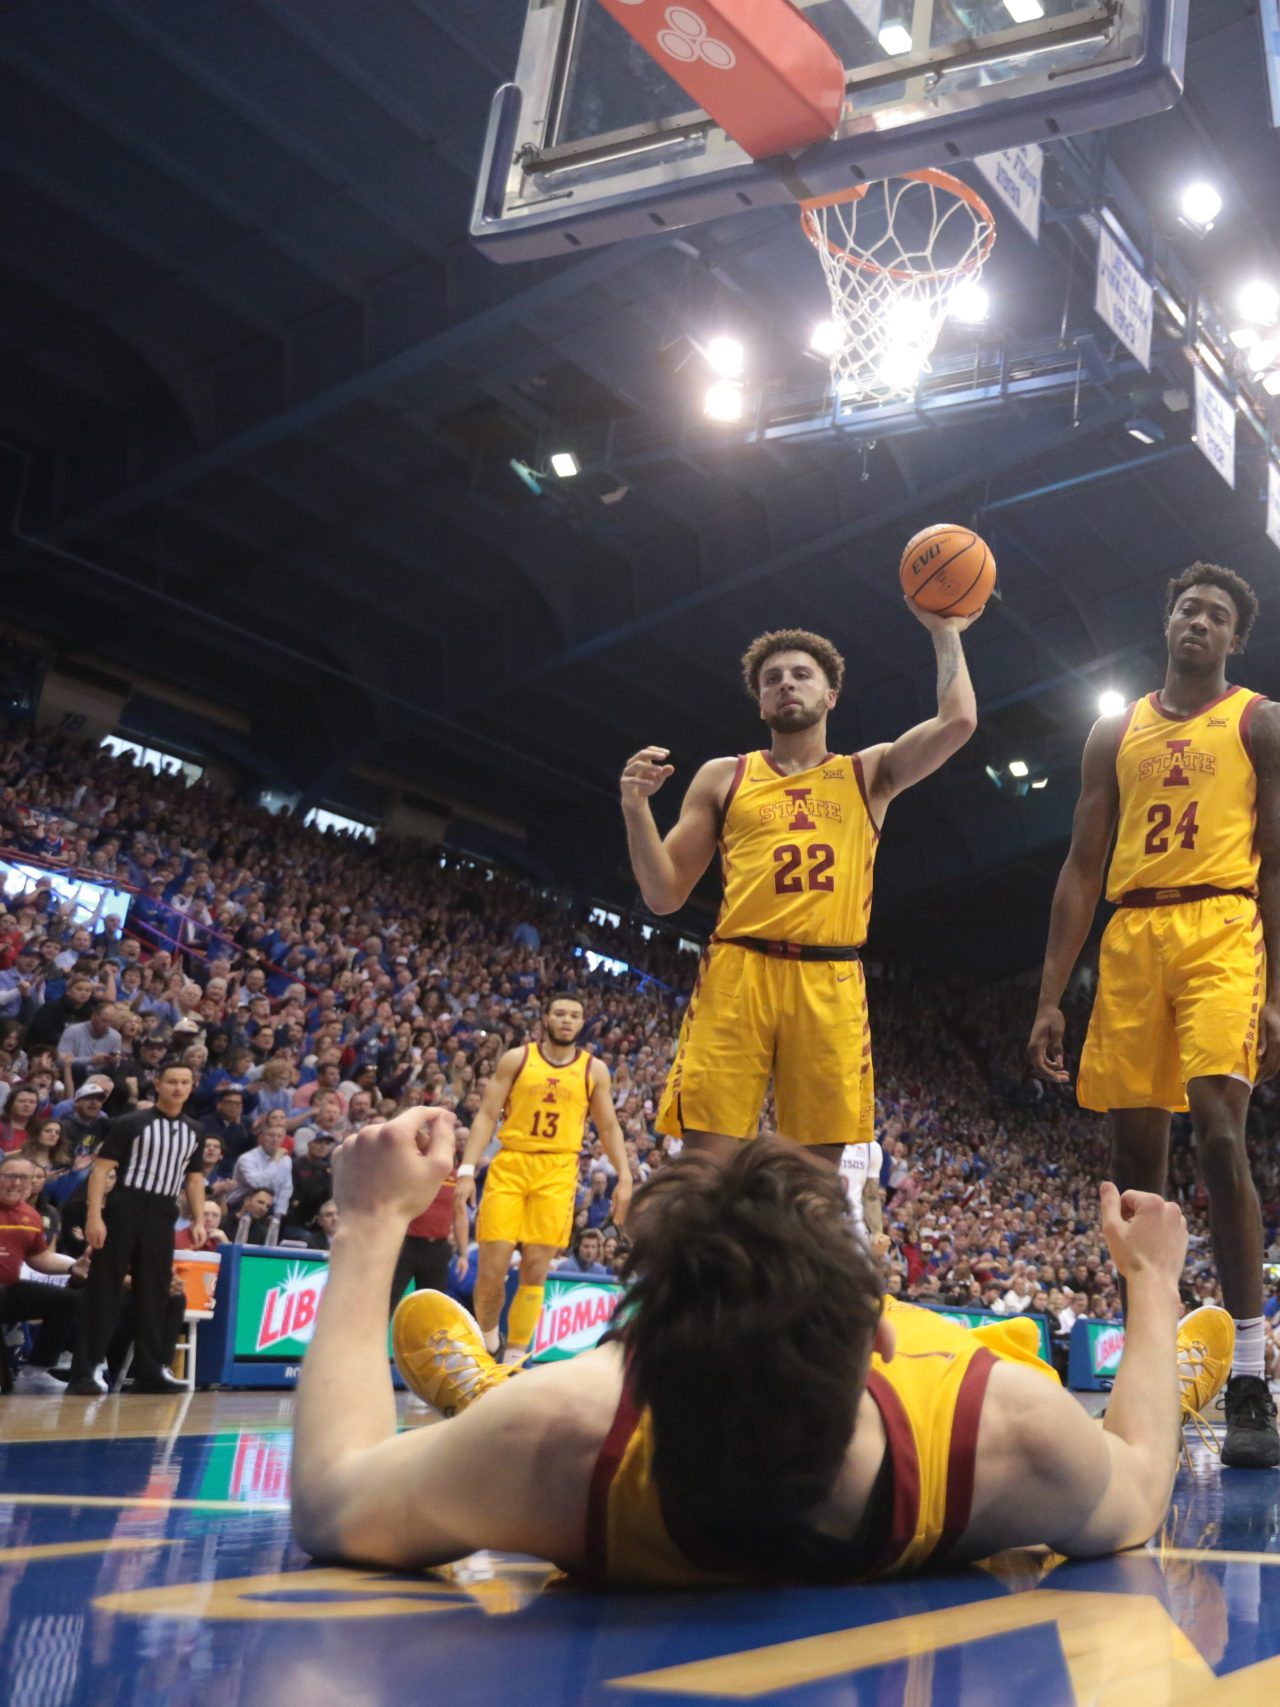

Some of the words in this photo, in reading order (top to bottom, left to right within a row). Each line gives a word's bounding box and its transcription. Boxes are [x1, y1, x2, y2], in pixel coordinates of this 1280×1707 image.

[1138, 751, 1216, 782] STATE
[759, 800, 841, 825] STATE
[1145, 801, 1199, 855] 24
[773, 843, 834, 894] 22
[530, 1111, 560, 1138] 13
[257, 1287, 321, 1349] LIB
